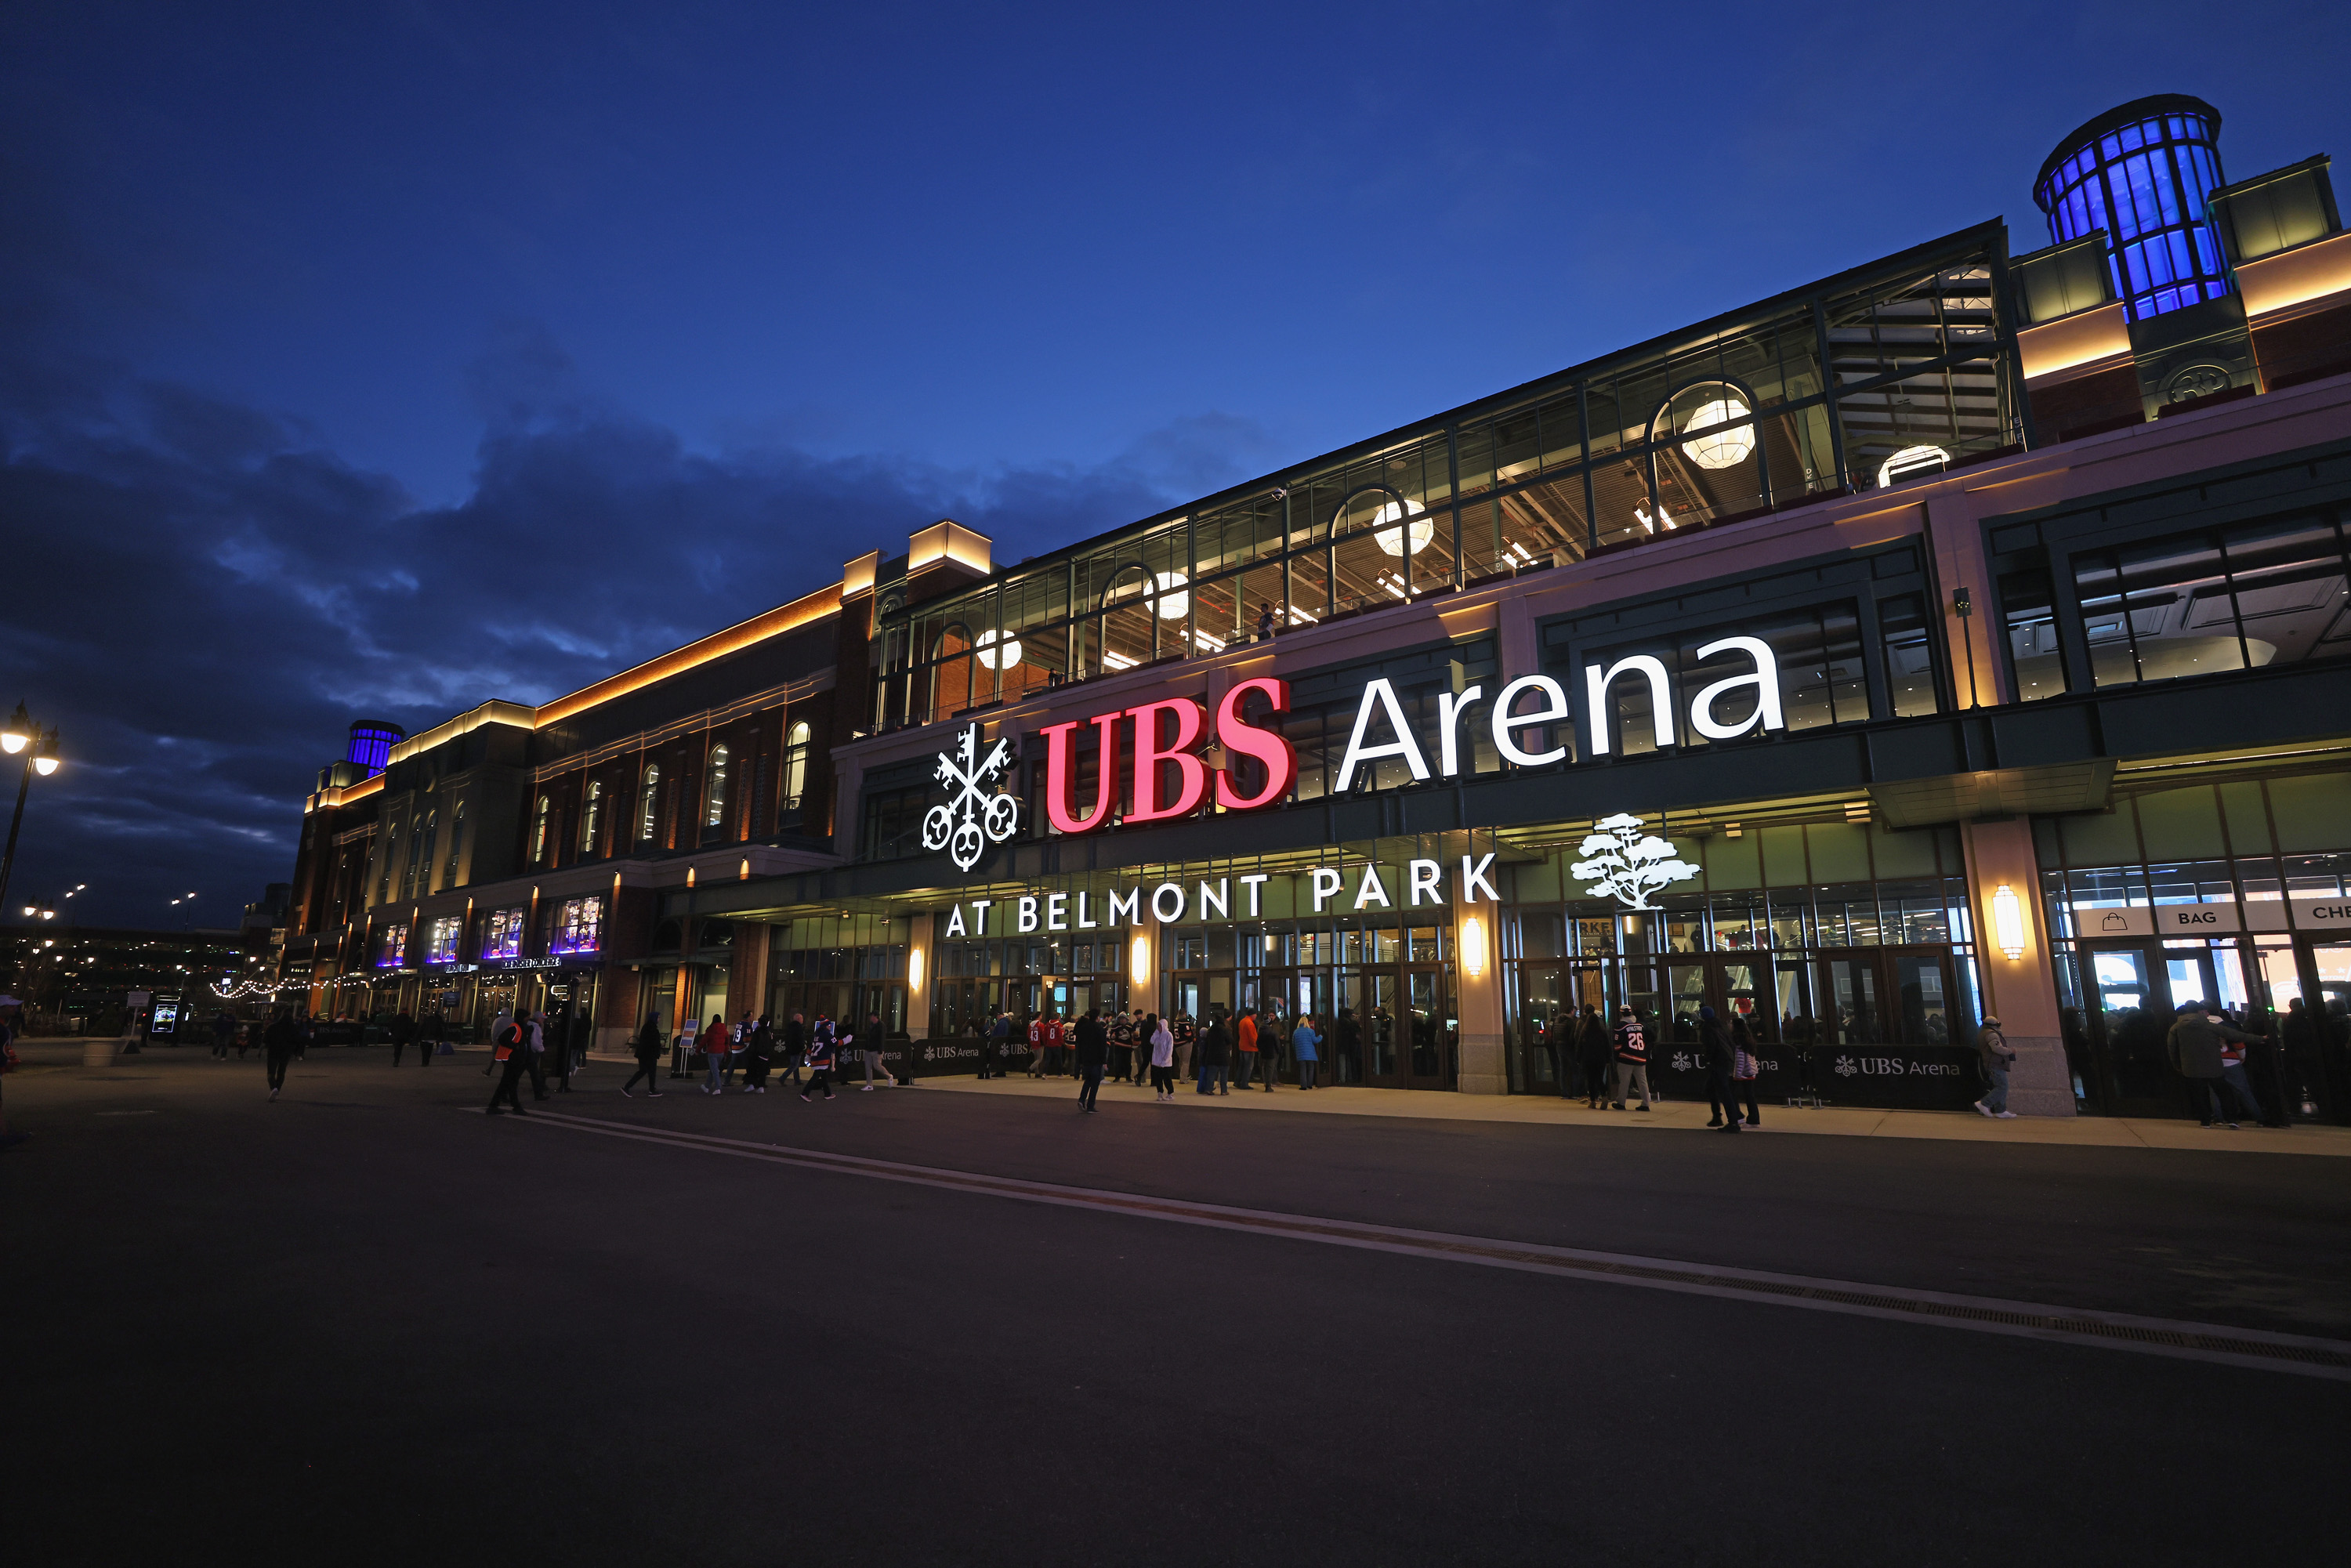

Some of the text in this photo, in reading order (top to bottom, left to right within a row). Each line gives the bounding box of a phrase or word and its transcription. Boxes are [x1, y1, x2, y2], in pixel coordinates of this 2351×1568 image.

[1038, 636, 1784, 833] UBS Arena
[945, 852, 1502, 937] AT BELMONT PARK
[2178, 911, 2217, 925] BAG
[733, 1028, 742, 1043] 19
[1049, 1027, 1056, 1040] 8
[1628, 1032, 1644, 1051] 26
[936, 1046, 979, 1059] UBS Arena
[1011, 1044, 1028, 1055] UBS
[1860, 1058, 1961, 1076] UBS Arena
